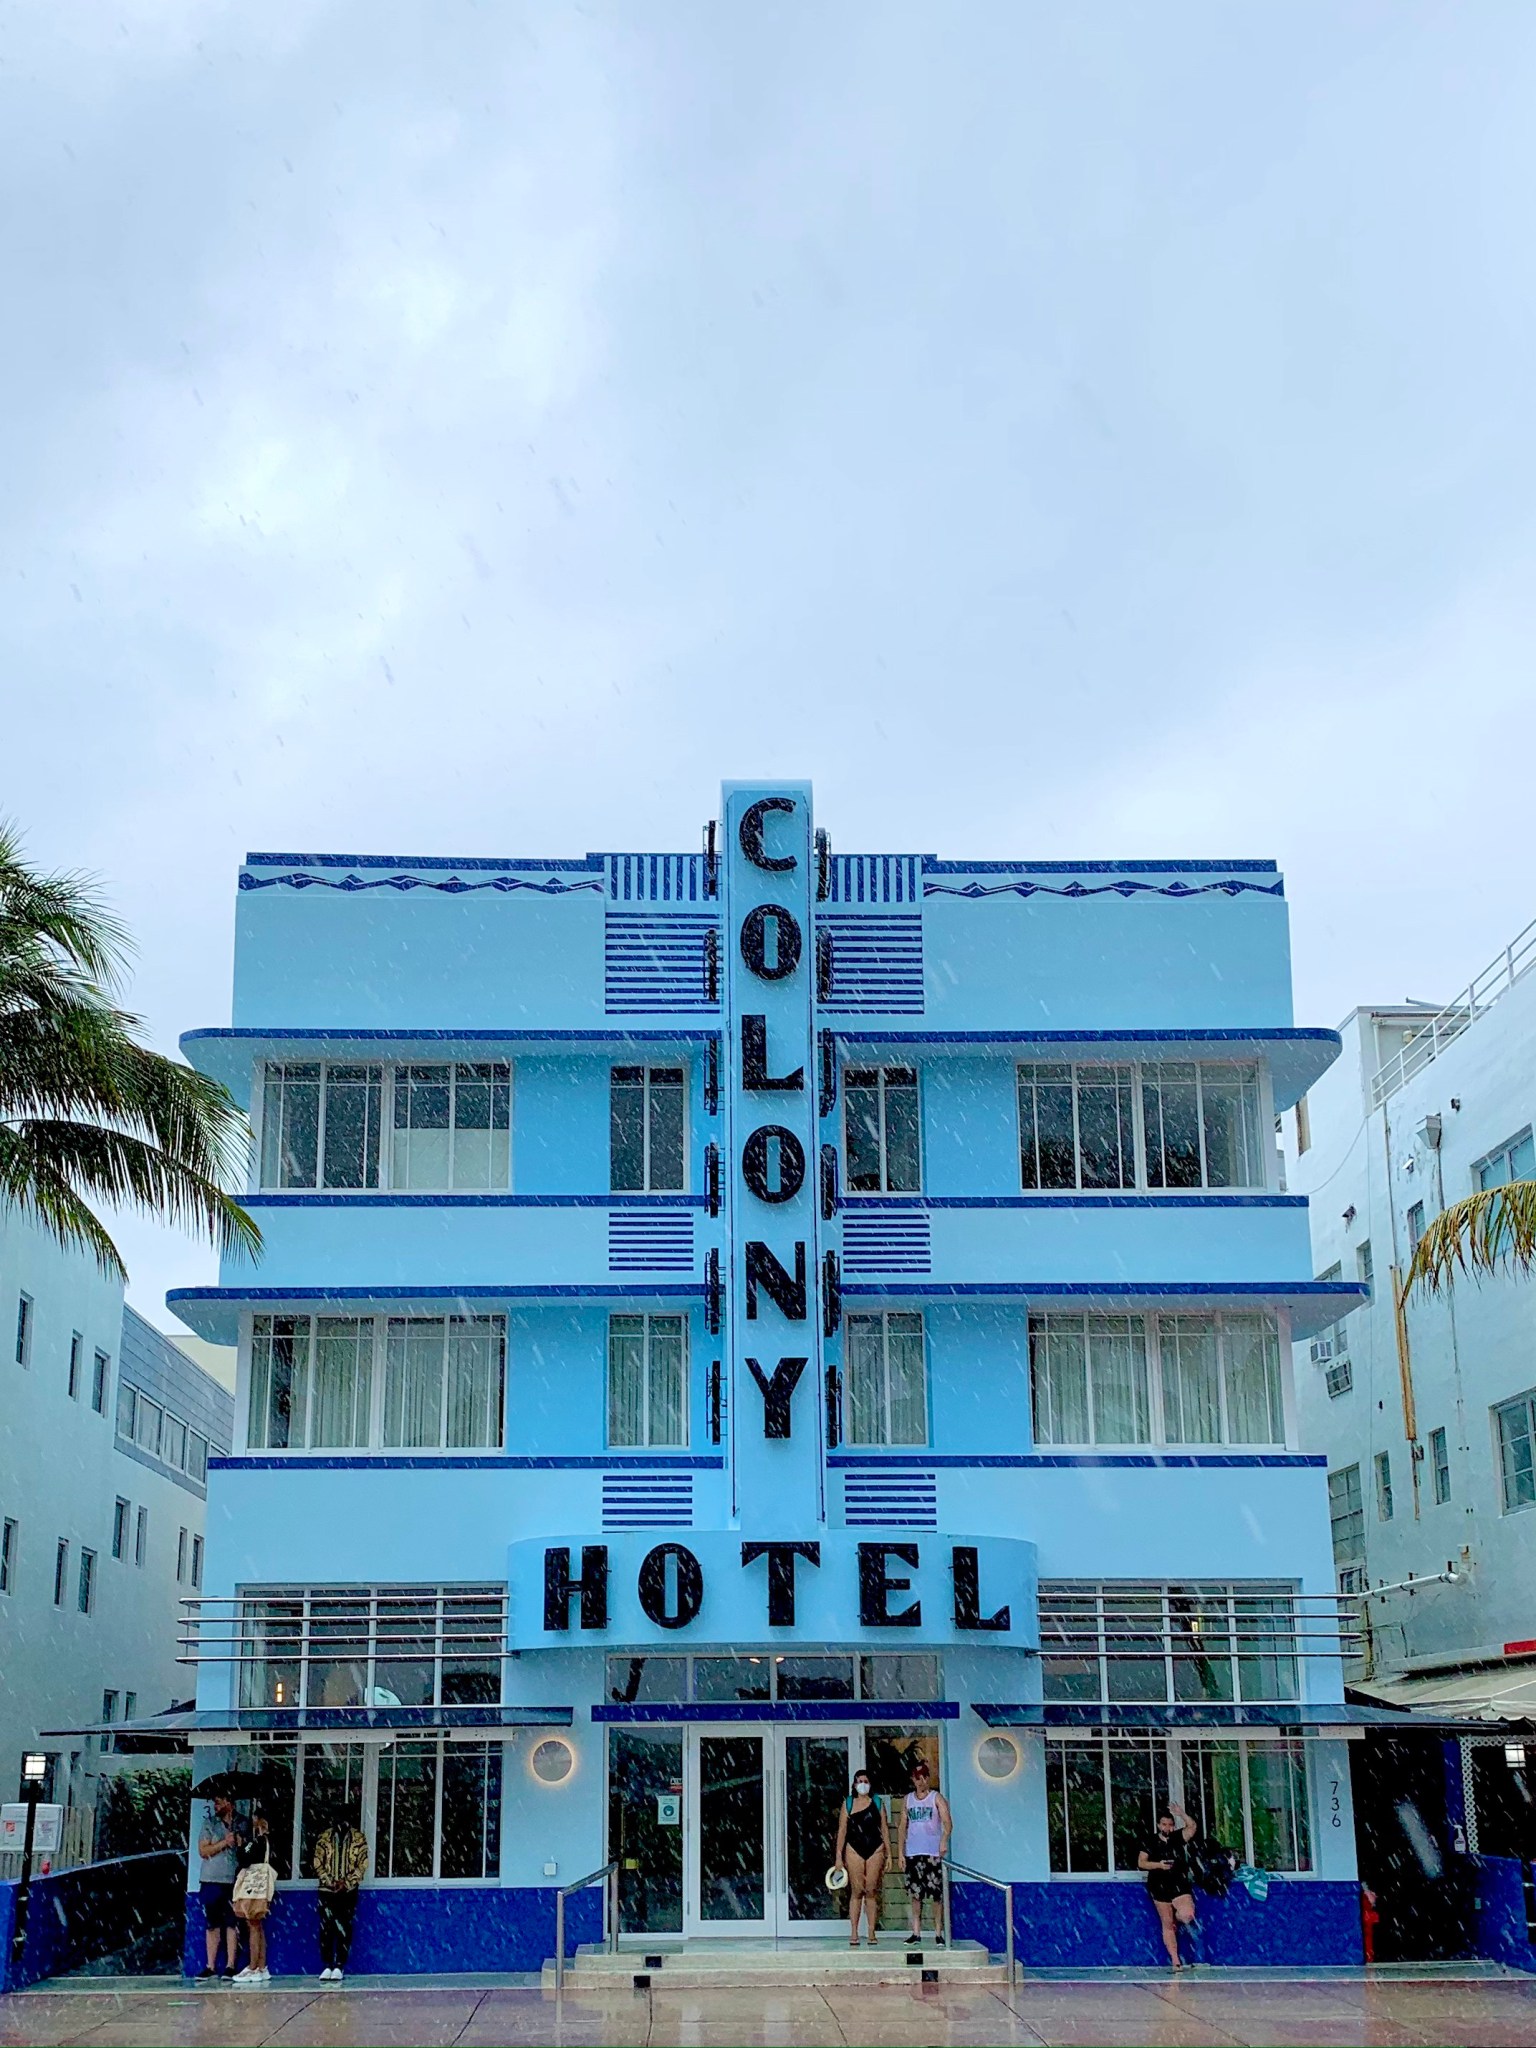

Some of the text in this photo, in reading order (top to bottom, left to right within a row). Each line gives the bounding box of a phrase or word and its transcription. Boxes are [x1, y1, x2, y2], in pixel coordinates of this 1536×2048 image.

[739, 797, 809, 1440] COLONY
[543, 1541, 1012, 1634] HOTEL
[1330, 1781, 1342, 1828] 736
